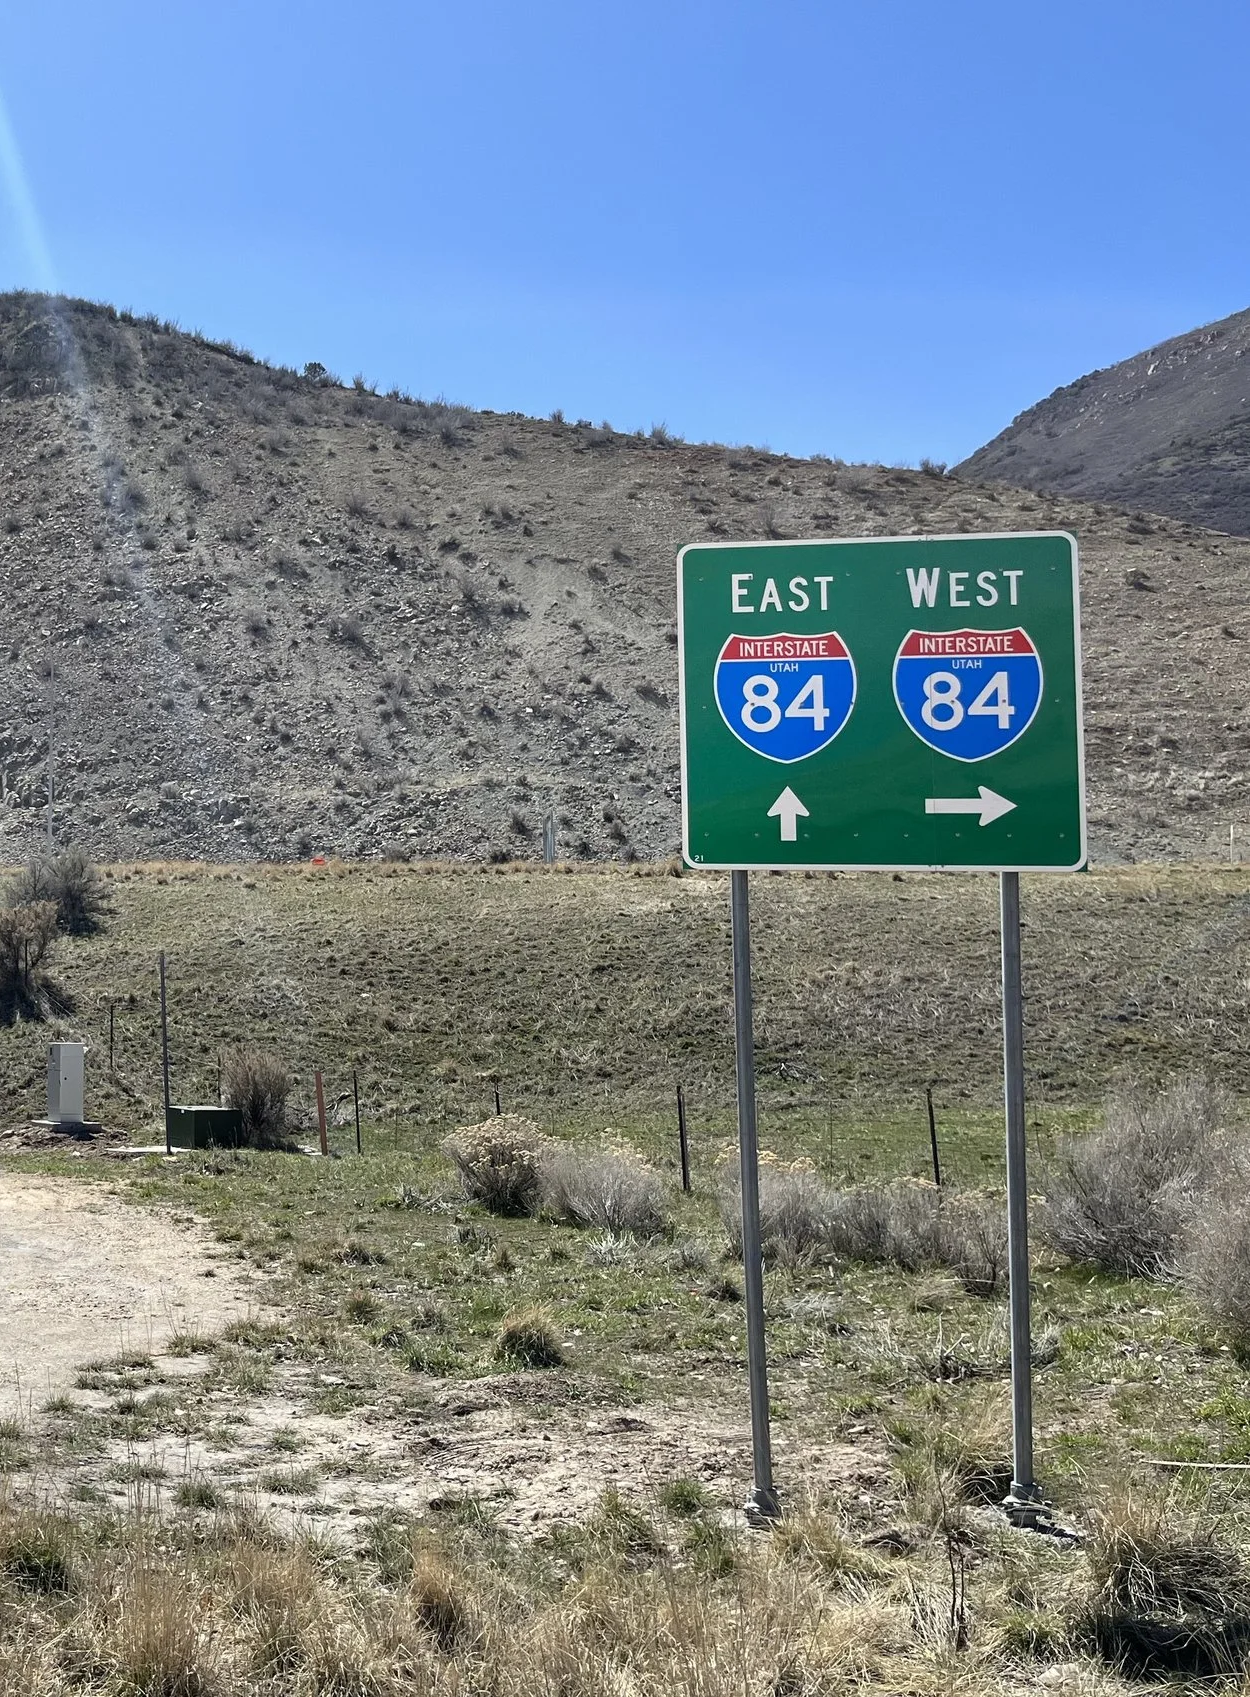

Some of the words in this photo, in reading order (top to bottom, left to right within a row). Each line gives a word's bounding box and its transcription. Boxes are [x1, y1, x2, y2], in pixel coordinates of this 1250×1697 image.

[731, 573, 834, 613] EAST
[906, 567, 1024, 608] WEST
[739, 640, 829, 657] INTERSTATE
[919, 636, 1014, 653] INTERSTATE
[770, 662, 799, 673] UTAH
[952, 659, 982, 669] UTAH
[741, 674, 830, 733] 84
[921, 671, 1015, 731] 84
